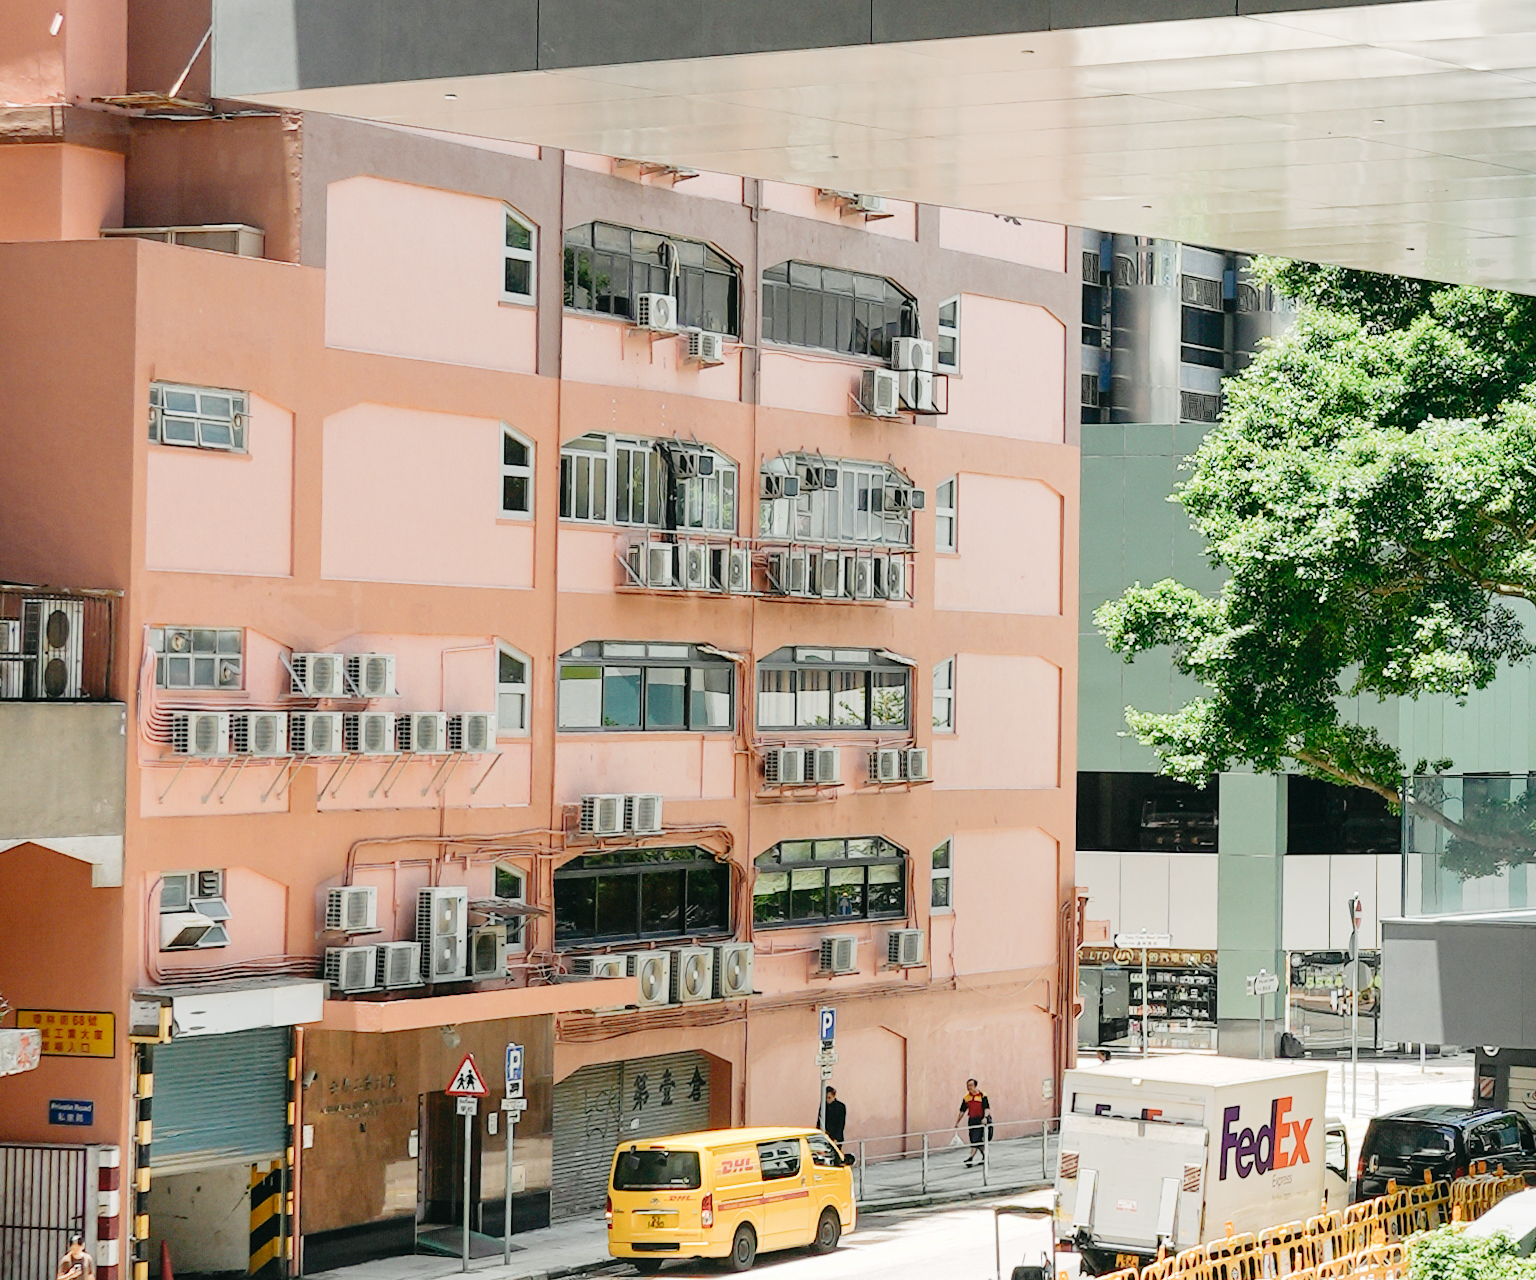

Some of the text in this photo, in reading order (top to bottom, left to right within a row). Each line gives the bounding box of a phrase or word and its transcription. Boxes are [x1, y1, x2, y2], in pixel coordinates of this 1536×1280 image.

[1090, 950, 1110, 961] LTD
[822, 1012, 833, 1038] P
[509, 1050, 521, 1080] P
[1219, 1096, 1313, 1181] FedEx
[721, 1157, 754, 1174] DHL
[1272, 1174, 1293, 1189] Express
